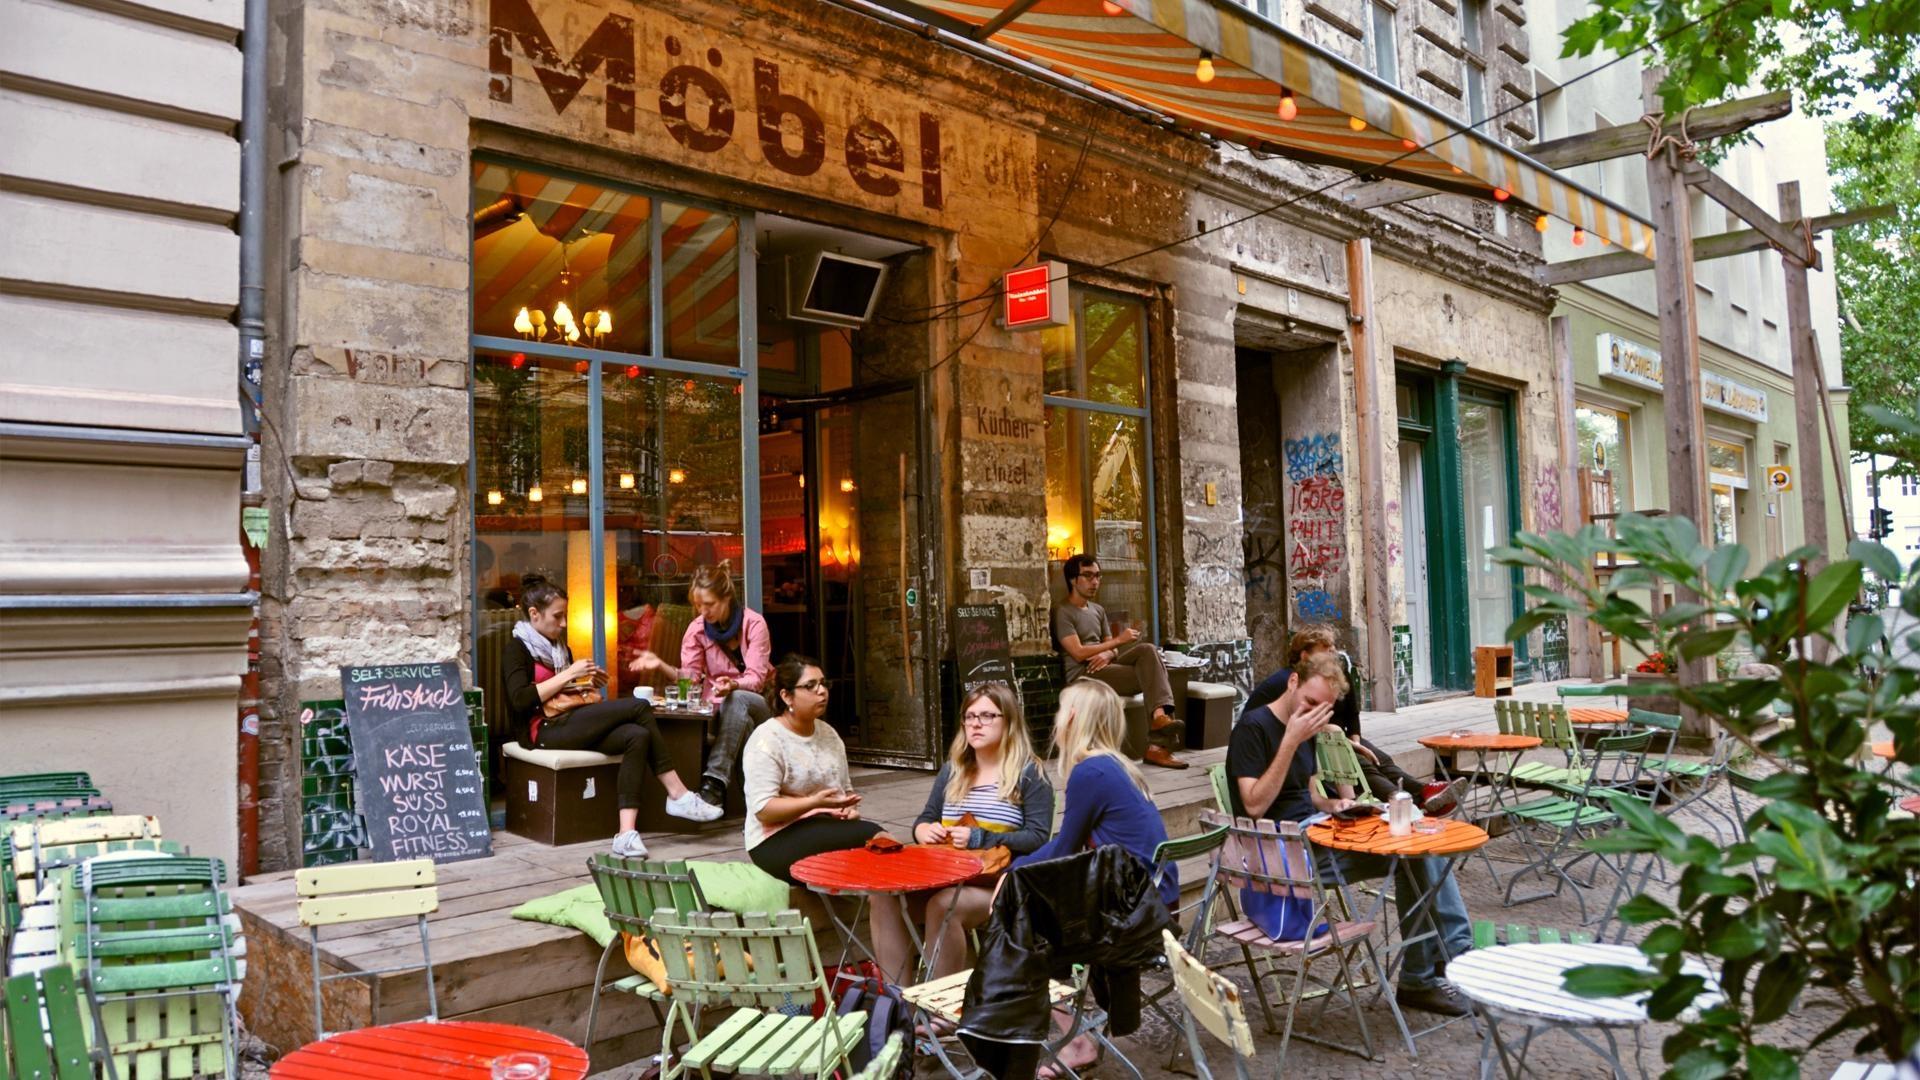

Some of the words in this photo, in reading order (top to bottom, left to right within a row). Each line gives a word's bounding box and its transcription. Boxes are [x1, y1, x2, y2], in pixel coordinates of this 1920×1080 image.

[489, 0, 944, 210] Möbel
[384, 744, 446, 768] KÄSE
[379, 770, 447, 793] WURST
[392, 792, 447, 813] SÜSS
[388, 813, 460, 835] ROYAL
